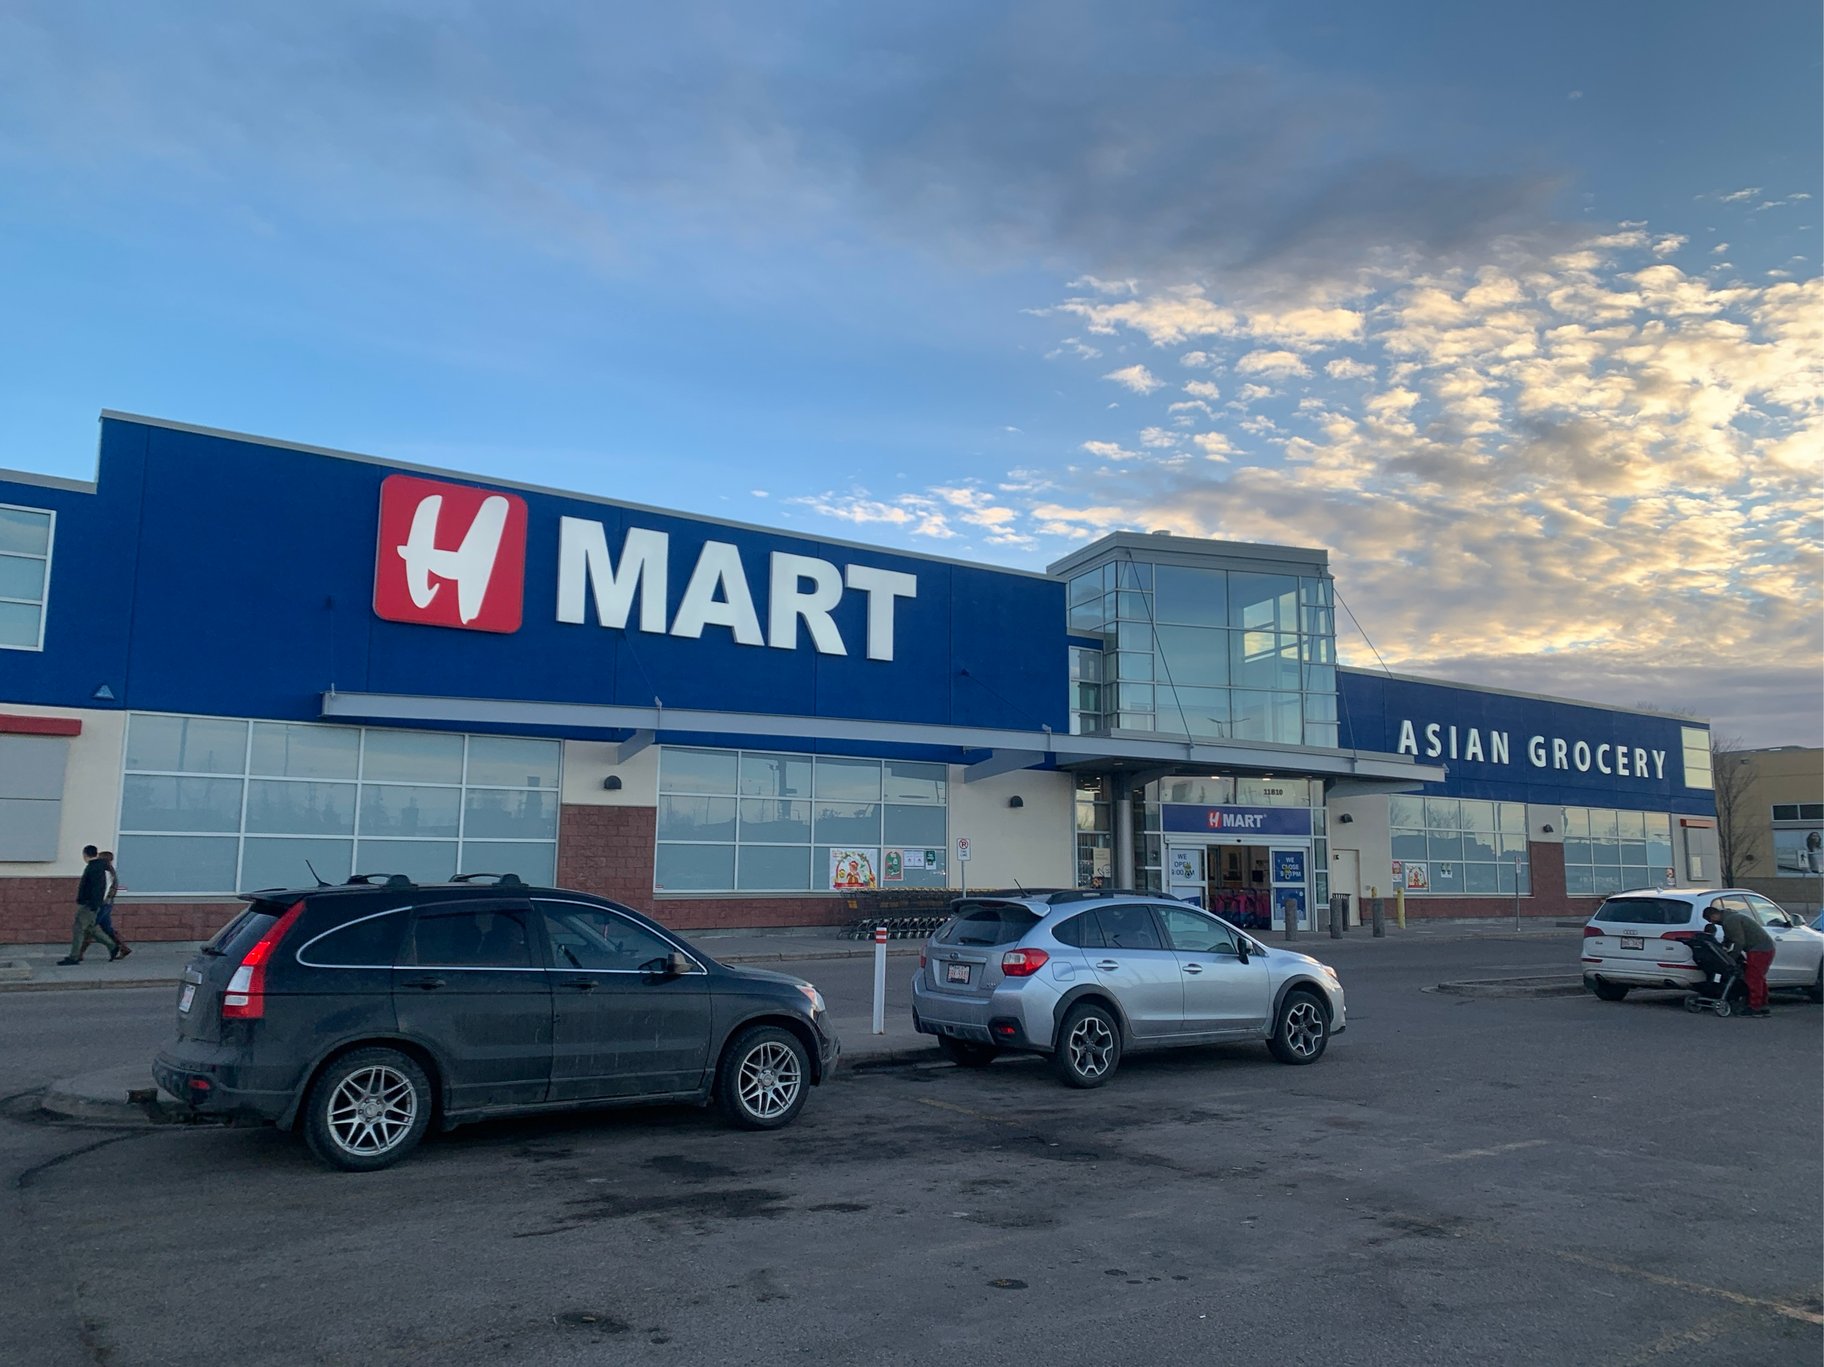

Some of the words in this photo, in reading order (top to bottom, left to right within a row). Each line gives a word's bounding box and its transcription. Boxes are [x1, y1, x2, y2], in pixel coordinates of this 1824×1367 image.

[397, 495, 509, 625] H
[556, 516, 917, 661] MART
[1397, 719, 1510, 765] ASIAN
[1528, 735, 1666, 779] GROCERY
[1263, 788, 1283, 796] 11810
[1223, 813, 1263, 828] MART
